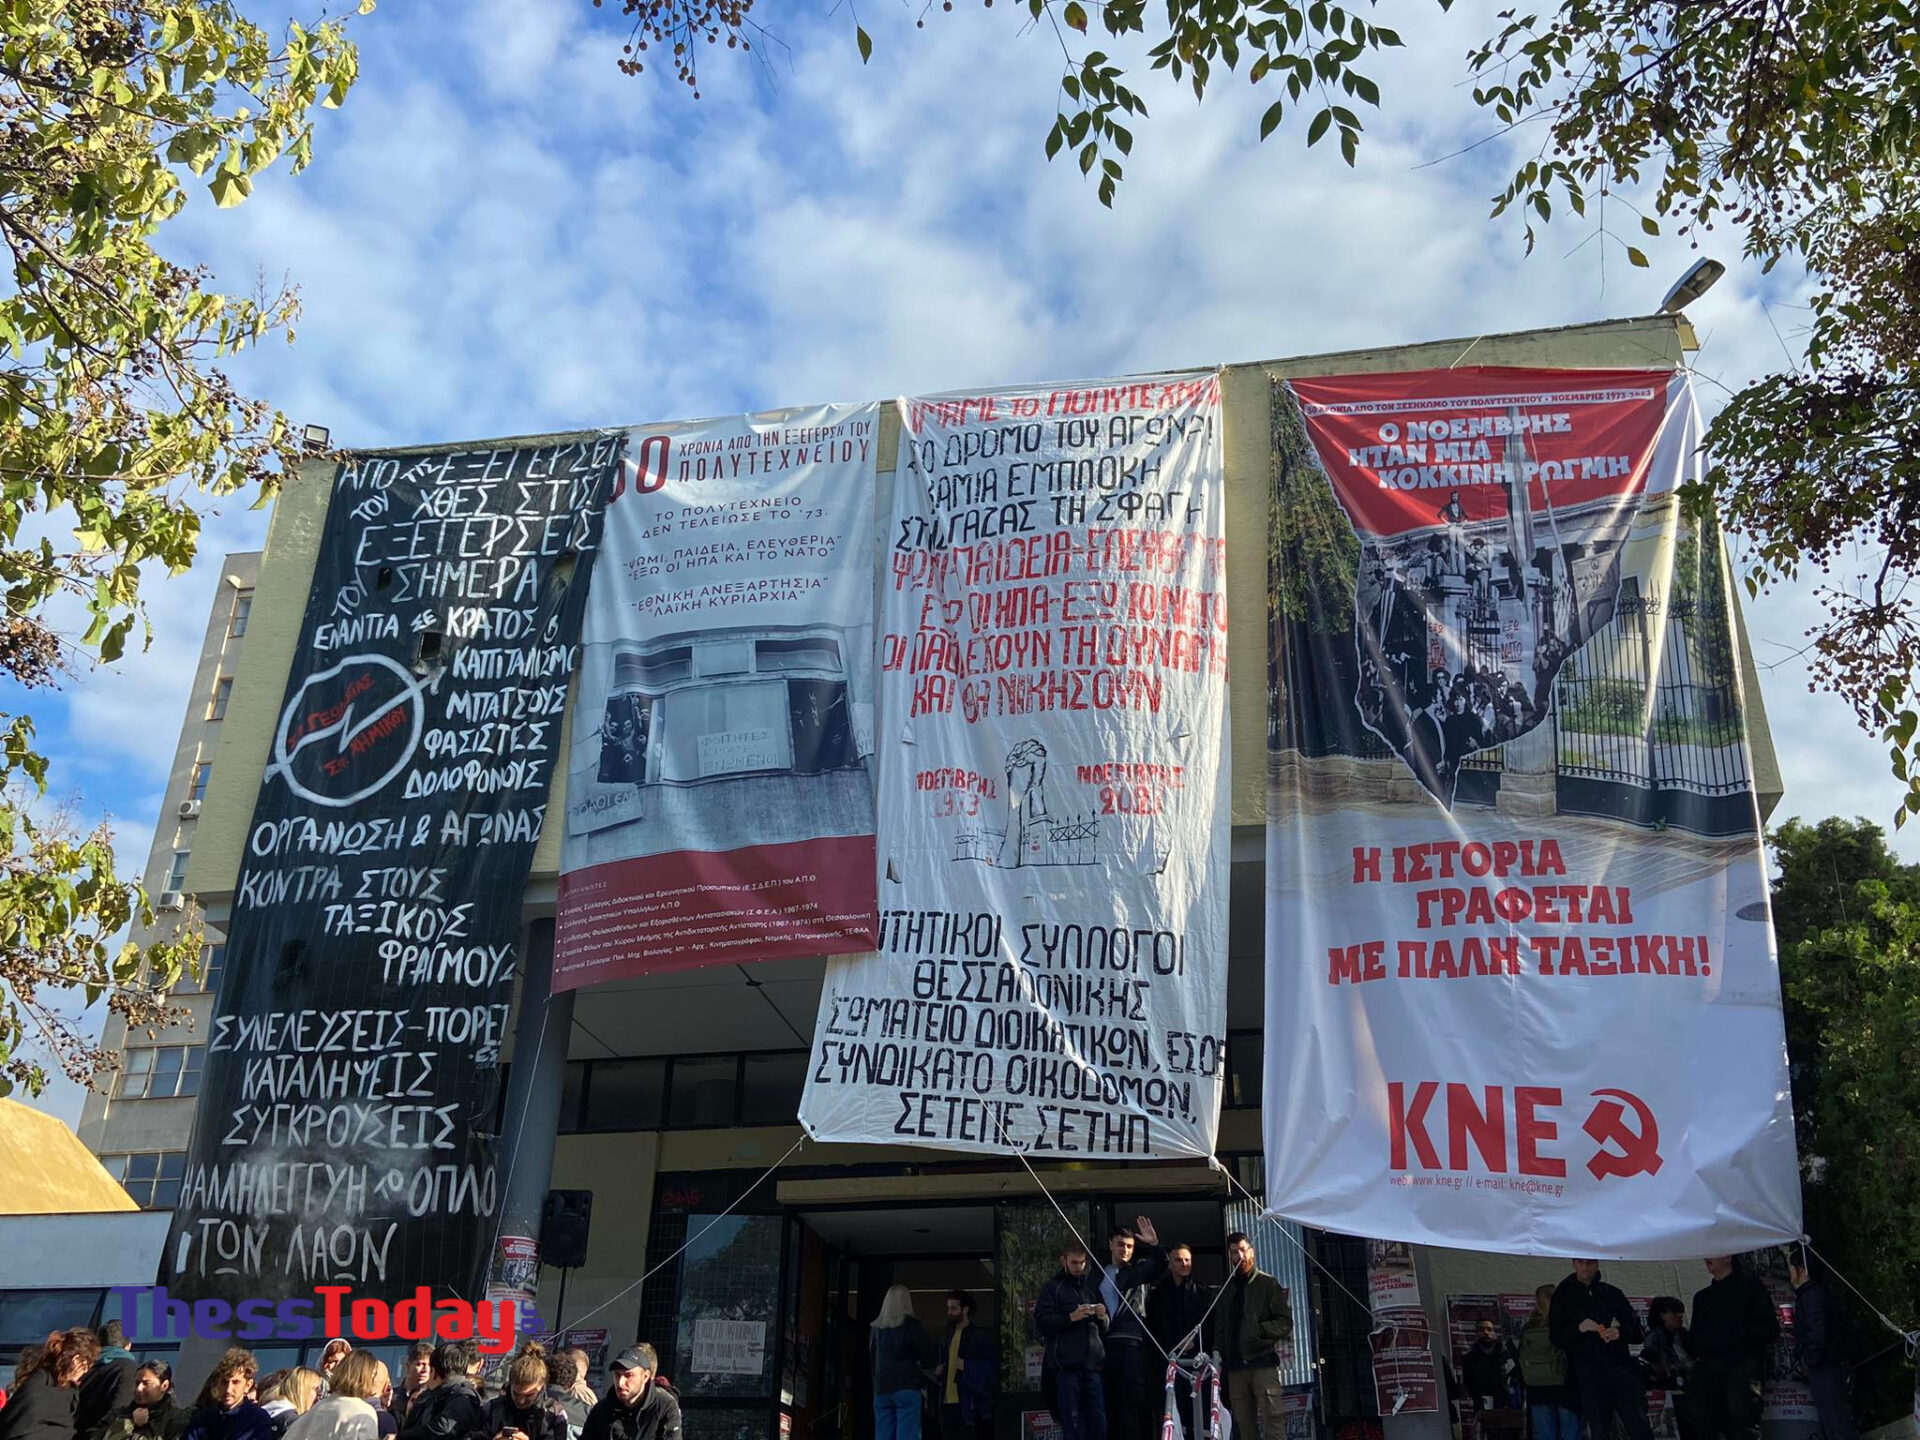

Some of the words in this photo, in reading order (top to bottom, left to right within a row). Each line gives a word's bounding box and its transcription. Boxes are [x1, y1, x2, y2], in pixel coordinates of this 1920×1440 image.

[1011, 397, 1039, 417] ΤΟ
[1306, 405, 1317, 414] 50
[1354, 404, 1373, 412] ΑΠΟ
[1375, 403, 1395, 411] ΤΟΝ
[1451, 399, 1468, 407] ΤΟΥ
[1470, 396, 1542, 406] ΠΟΛΥΤΕΧΝΕΙΟΥ
[1551, 392, 1604, 402] ΝΟΕΜΒΡΗΣ
[679, 440, 723, 457] ΧΡΟΝΙΑ
[728, 435, 751, 451] ΑΠΟ
[757, 431, 780, 449] ΤΗΝ
[785, 424, 845, 445] ΕΞΕΓΕΡΣΗ
[849, 420, 872, 437] ΤΟΥ
[943, 424, 1042, 467] ΔΡΟΜΟ
[1055, 418, 1099, 448] ΤΟΥ
[1378, 422, 1400, 443] Ο
[1407, 413, 1571, 442] ΝΟΕΜΒΡΗΣ
[679, 438, 870, 483] ΠΟΛΥΤΕΧΝΕΙΟΥ
[1349, 444, 1427, 467] ΗΤΑΝ
[1434, 440, 1489, 464] ΜΙΑ
[1378, 462, 1516, 490] ΚΟΚΚΙΝΗ
[1526, 456, 1631, 482] ΡΩΓΜΗ
[337, 458, 399, 492] ΑΠΟ
[1008, 455, 1161, 497] ΕΜΠΛΟΚΗ
[350, 490, 389, 521] ΤΟΥ
[412, 484, 497, 520] ΧΘΕΣ
[655, 511, 674, 522] ΤΟ
[682, 496, 802, 518] ΠΟΛΥΤΕΧΝΕΙΟ
[948, 500, 1037, 543] ΓΑΖΑΣ
[1051, 495, 1086, 525] ΤΗ
[355, 507, 603, 566] ΕΞΕΓΕΡΣΕΙΣ
[642, 524, 671, 539] ΔΕΝ
[679, 511, 761, 531] ΤΕΛΕΙΩΣΕ
[769, 509, 791, 521] ΤΟ
[665, 560, 680, 573] ΟΙ
[686, 555, 719, 569] ΗΠΑ
[725, 551, 751, 563] ΚΑΙ
[758, 549, 778, 561] ΤΟ
[331, 567, 368, 617] ΤΟΥ
[391, 556, 538, 602] ΣΗΜΕΡΑ
[313, 613, 399, 651] ΕΝΑΝΤΙΑ
[411, 609, 438, 633] ΣΕ
[446, 606, 540, 641] ΚΡΑΤΟΣ
[969, 591, 991, 634] ΟΙ
[1128, 582, 1156, 620] ΤΟ
[883, 634, 907, 671] ΟΙ
[966, 630, 1050, 676] ΕΧΟΥΝ
[1060, 625, 1098, 666] ΤΗ
[446, 684, 568, 723] ΜΠΑΤΣΟΥΣ
[910, 674, 955, 718] ΚΑΙ
[963, 680, 990, 724] ΘΑ
[997, 669, 1161, 714] ΝΙΚΗΣΟΥΝ
[423, 721, 550, 757] ΦΑΣΙΣΤΕΣ
[401, 759, 548, 800] ΔΟΛΟΦΟΝΟΥΣ
[252, 816, 406, 857] ΟΡΓΑΝΩΣΗ
[410, 813, 431, 848] &
[440, 803, 547, 848] ΑΓΩΝΑΣ
[1353, 847, 1381, 884] Η
[1392, 840, 1566, 883] ΙΣΤΟΡΙΑ
[237, 865, 343, 909] ΚΟΝΤΡΑ
[353, 866, 448, 903] ΣΤΟΥΣ
[656, 887, 696, 898] Ερευνητικού
[697, 883, 741, 893] Προσωπικού
[783, 902, 819, 914] 1967-1974
[1417, 886, 1634, 928] ΓΡΑΦΕΤΑΙ
[324, 901, 475, 943] ΤΑΞΙΚΟΥΣ
[614, 937, 636, 946] Χώρου
[637, 932, 662, 942] Μνήμης
[663, 930, 674, 938] της
[674, 925, 729, 937] Αντιδικτατορικής
[812, 916, 825, 925] στη
[826, 912, 871, 922] Θεσσαλονίκη
[623, 904, 659, 916] Υπαλλήλων
[845, 926, 870, 935] ΤΕΦΑΑ
[877, 910, 1002, 957] ΙΤΗΤΙΚΟΙ
[1020, 924, 1184, 976] ΣΥΛΛΟΓΟΙ
[1328, 941, 1385, 985] ΜΕ
[1397, 936, 1521, 979] ΠΑΛΗ
[1530, 935, 1711, 977] ΤΑΞΙΚΗ!
[913, 959, 1150, 1022] ΘΕΣΣΑΛΟΝΙΚΗΣ
[826, 995, 968, 1044] ΣΩΜΑΤΕΙΟ
[241, 1052, 439, 1103] ΚΑΤΑΛΗΨΕΙΣ
[814, 1041, 993, 1095] ΣΥΝΔΙΚΑΤΟ
[221, 1103, 460, 1149] ΣΥΓΚΡΟΥΣΕΙΣ
[374, 1168, 404, 1200] ΤΟ
[407, 1164, 497, 1217] ΟΠΛΟ
[1412, 1174, 1463, 1191] www.kne.gr
[1476, 1177, 1507, 1191] e-mail:
[1509, 1180, 1564, 1198] kne@kne.gr
[199, 1218, 270, 1280] ΤΩΝ
[285, 1222, 398, 1282] ΛΑΩΝ
